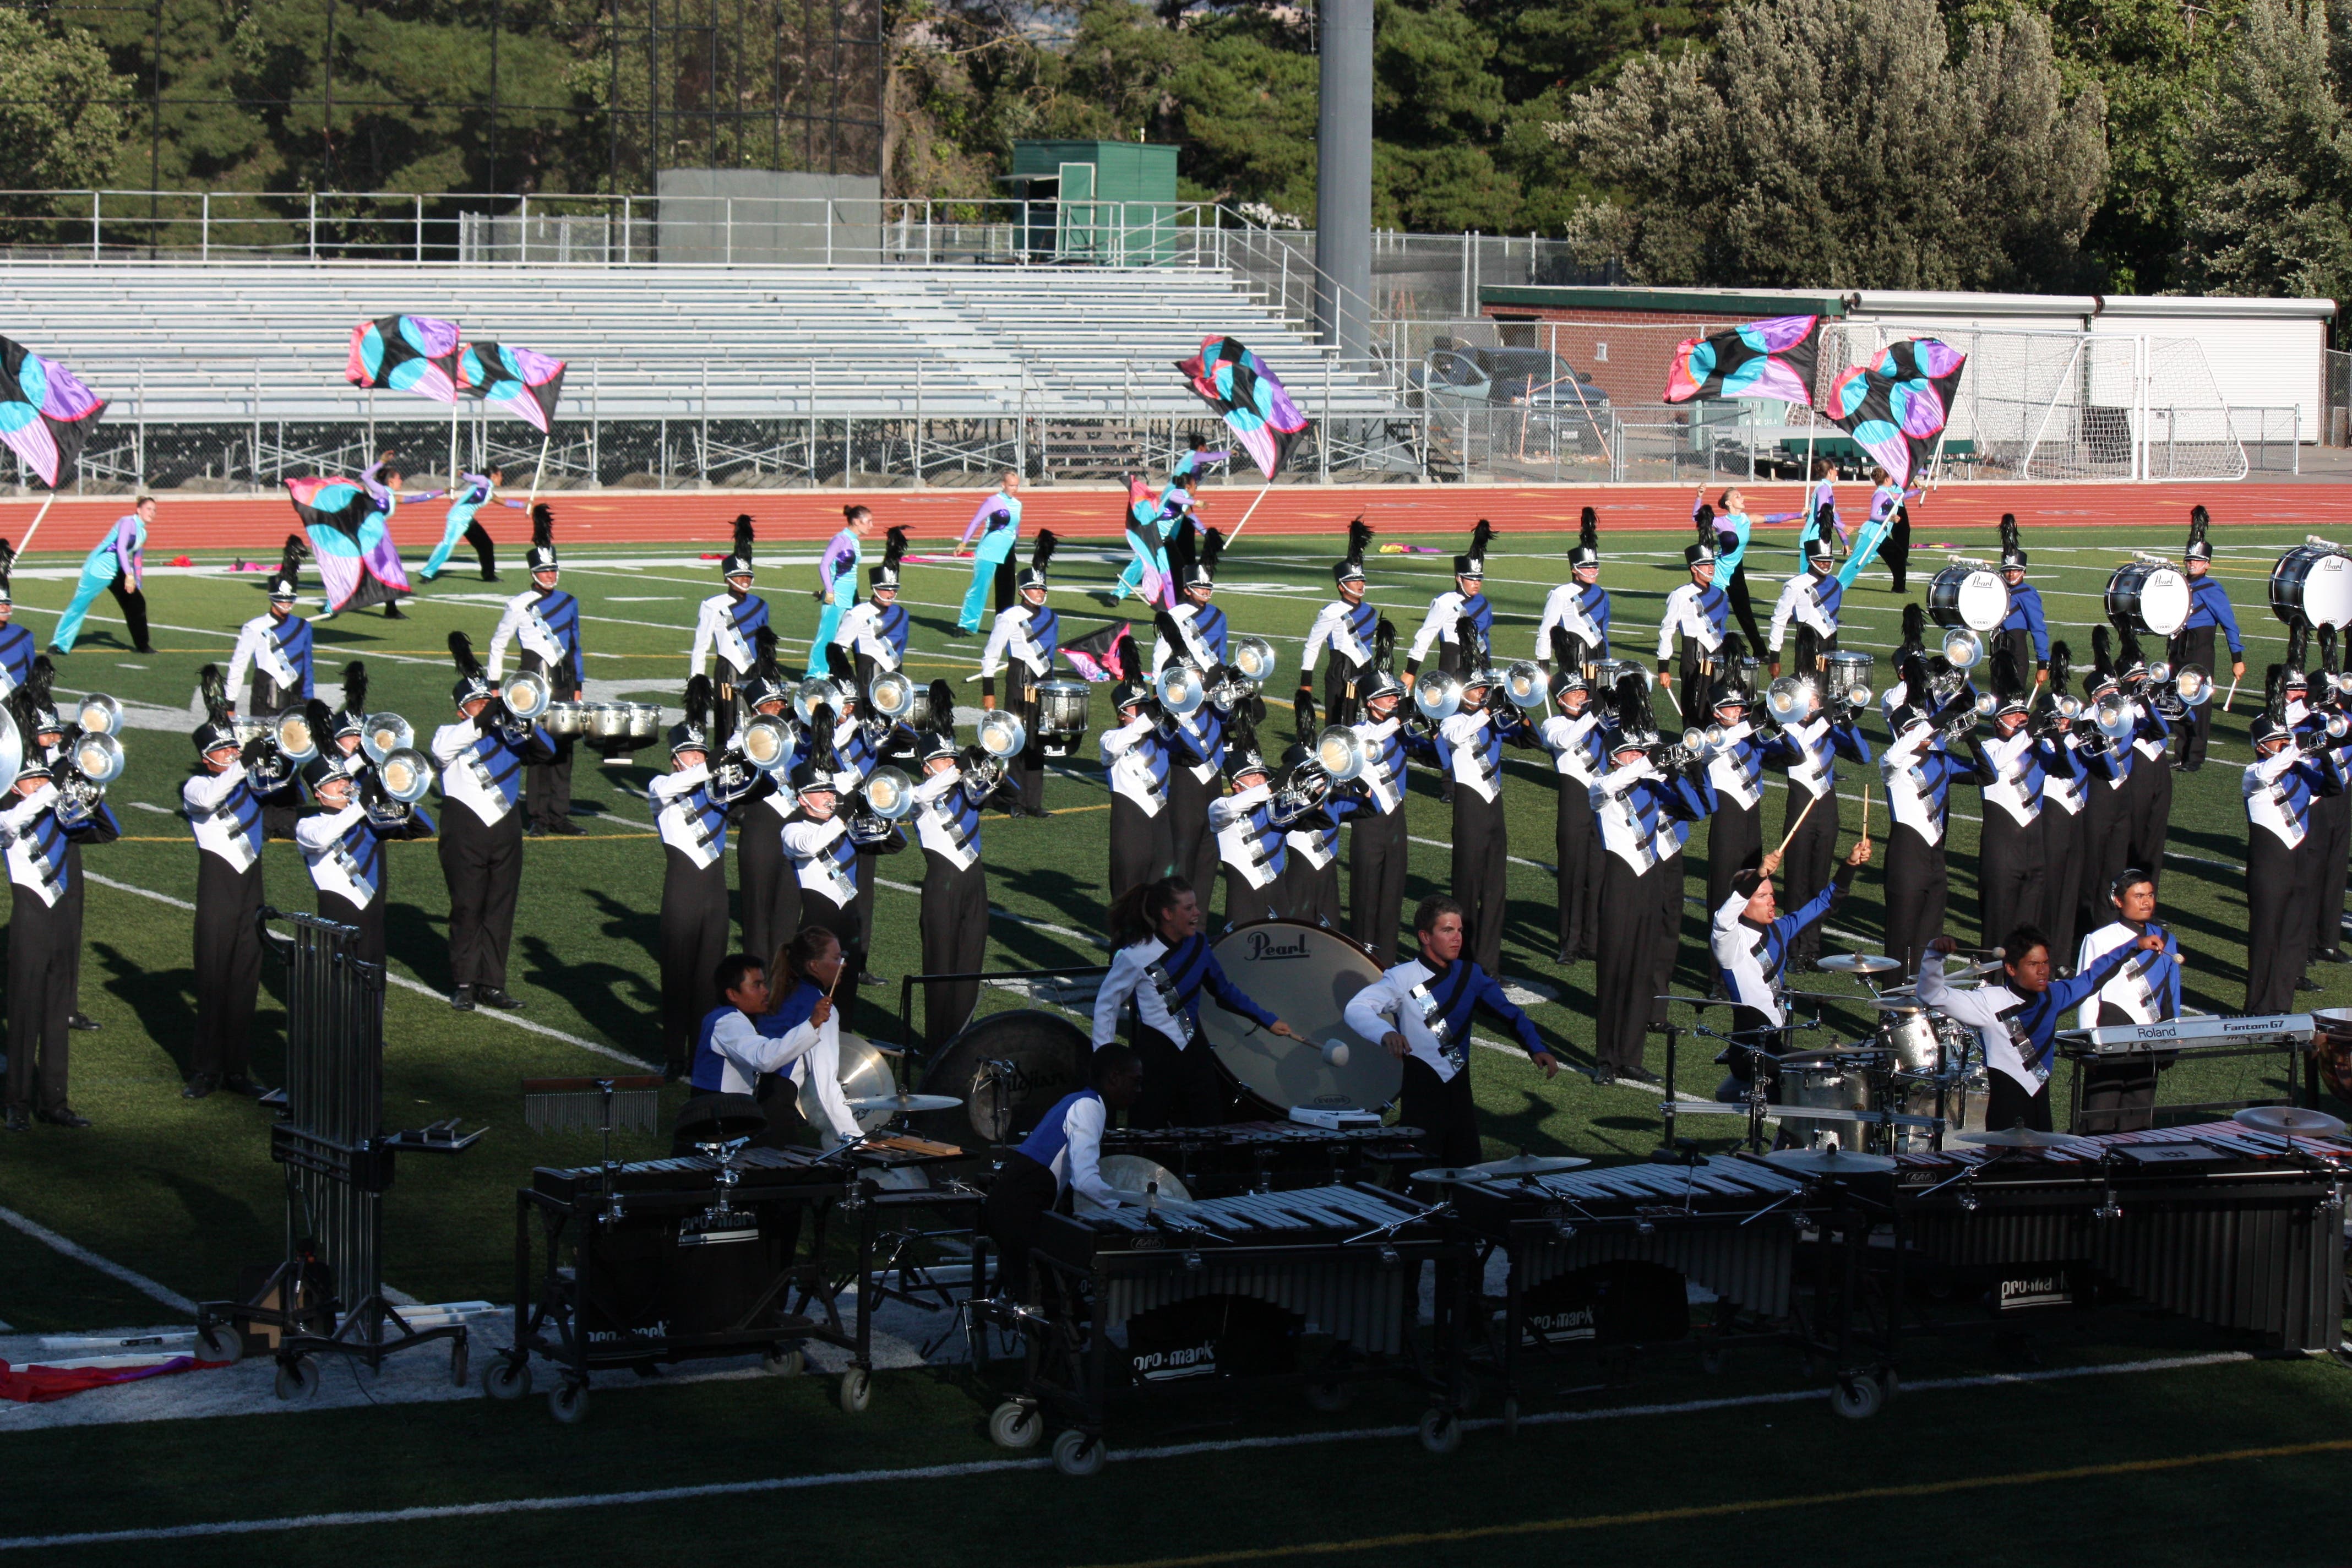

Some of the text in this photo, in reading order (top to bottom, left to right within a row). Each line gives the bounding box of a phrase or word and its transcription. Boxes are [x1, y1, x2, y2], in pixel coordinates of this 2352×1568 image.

[1972, 574, 1994, 587] Pearl
[2153, 573, 2174, 586] Pearl
[1244, 931, 1307, 961] Pearl
[2137, 1020, 2284, 1038] Roland Fantom G7
